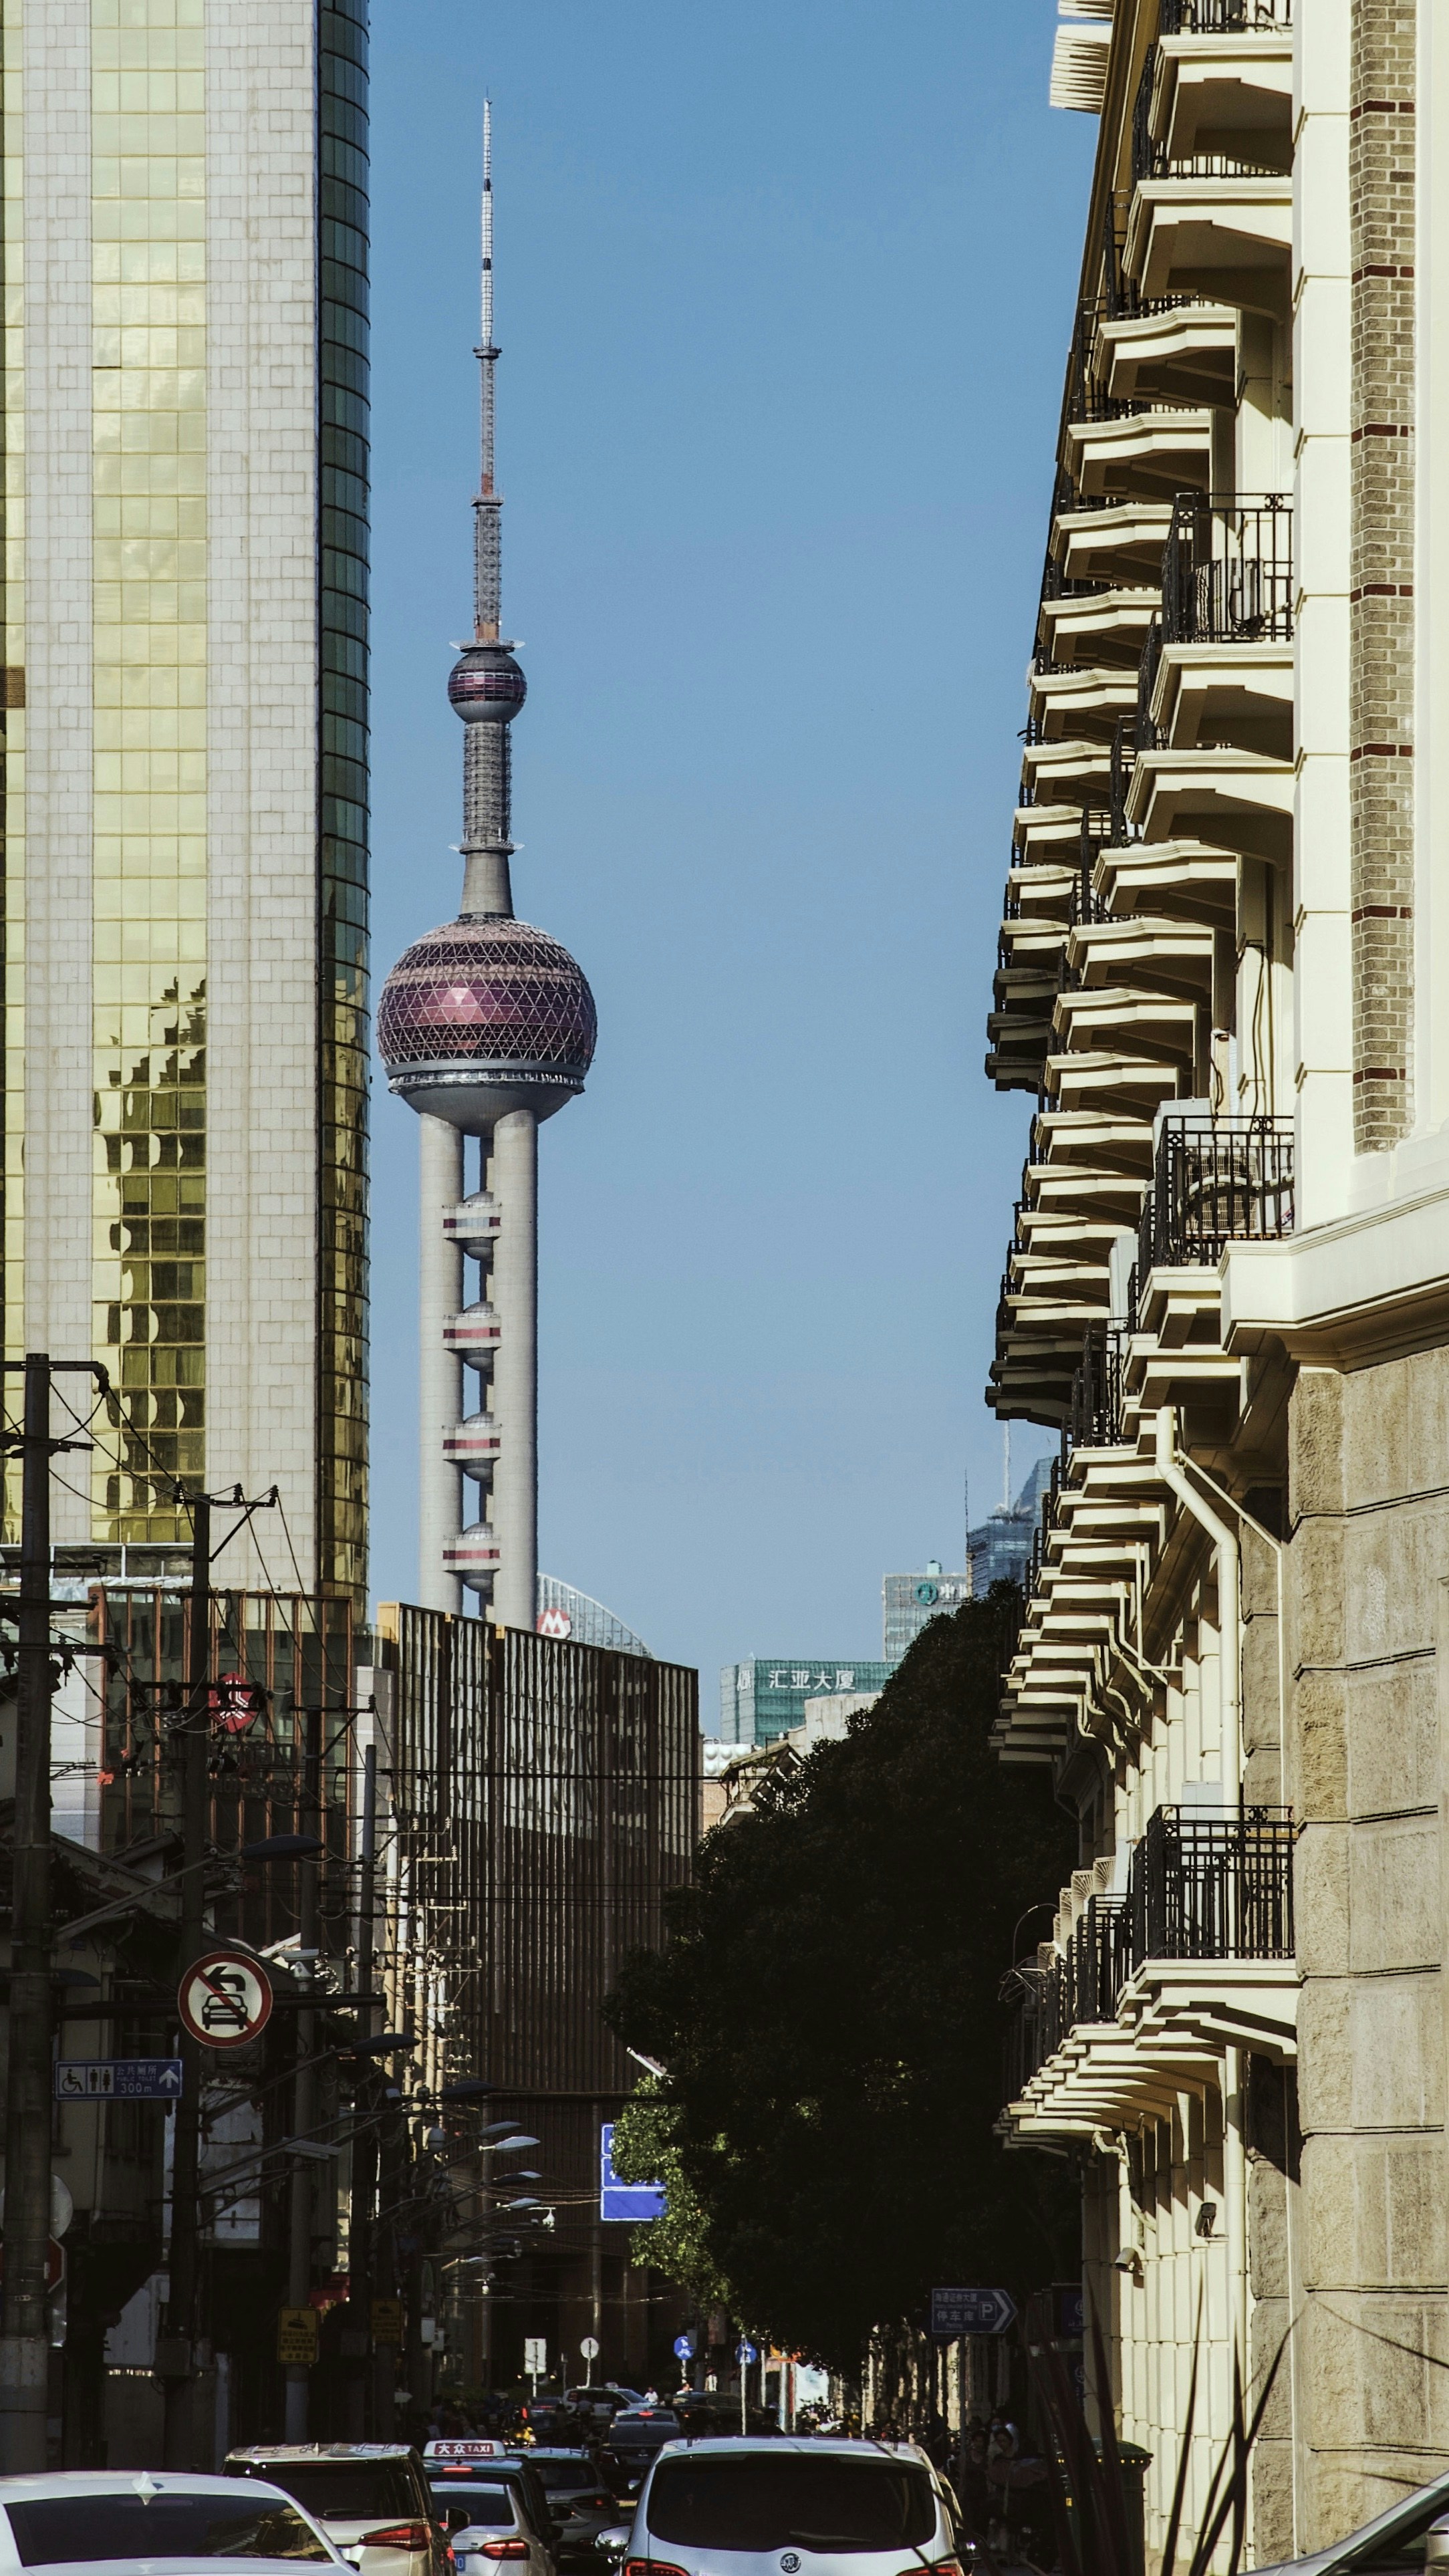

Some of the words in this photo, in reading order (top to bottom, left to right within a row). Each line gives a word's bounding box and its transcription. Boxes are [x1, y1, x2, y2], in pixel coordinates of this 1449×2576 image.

[769, 1670, 856, 1690] 汇亚大厦
[120, 2083, 152, 2094] 300m
[937, 2310, 974, 2322] 停车库
[981, 2303, 993, 2318] P
[438, 2444, 466, 2454] 大众
